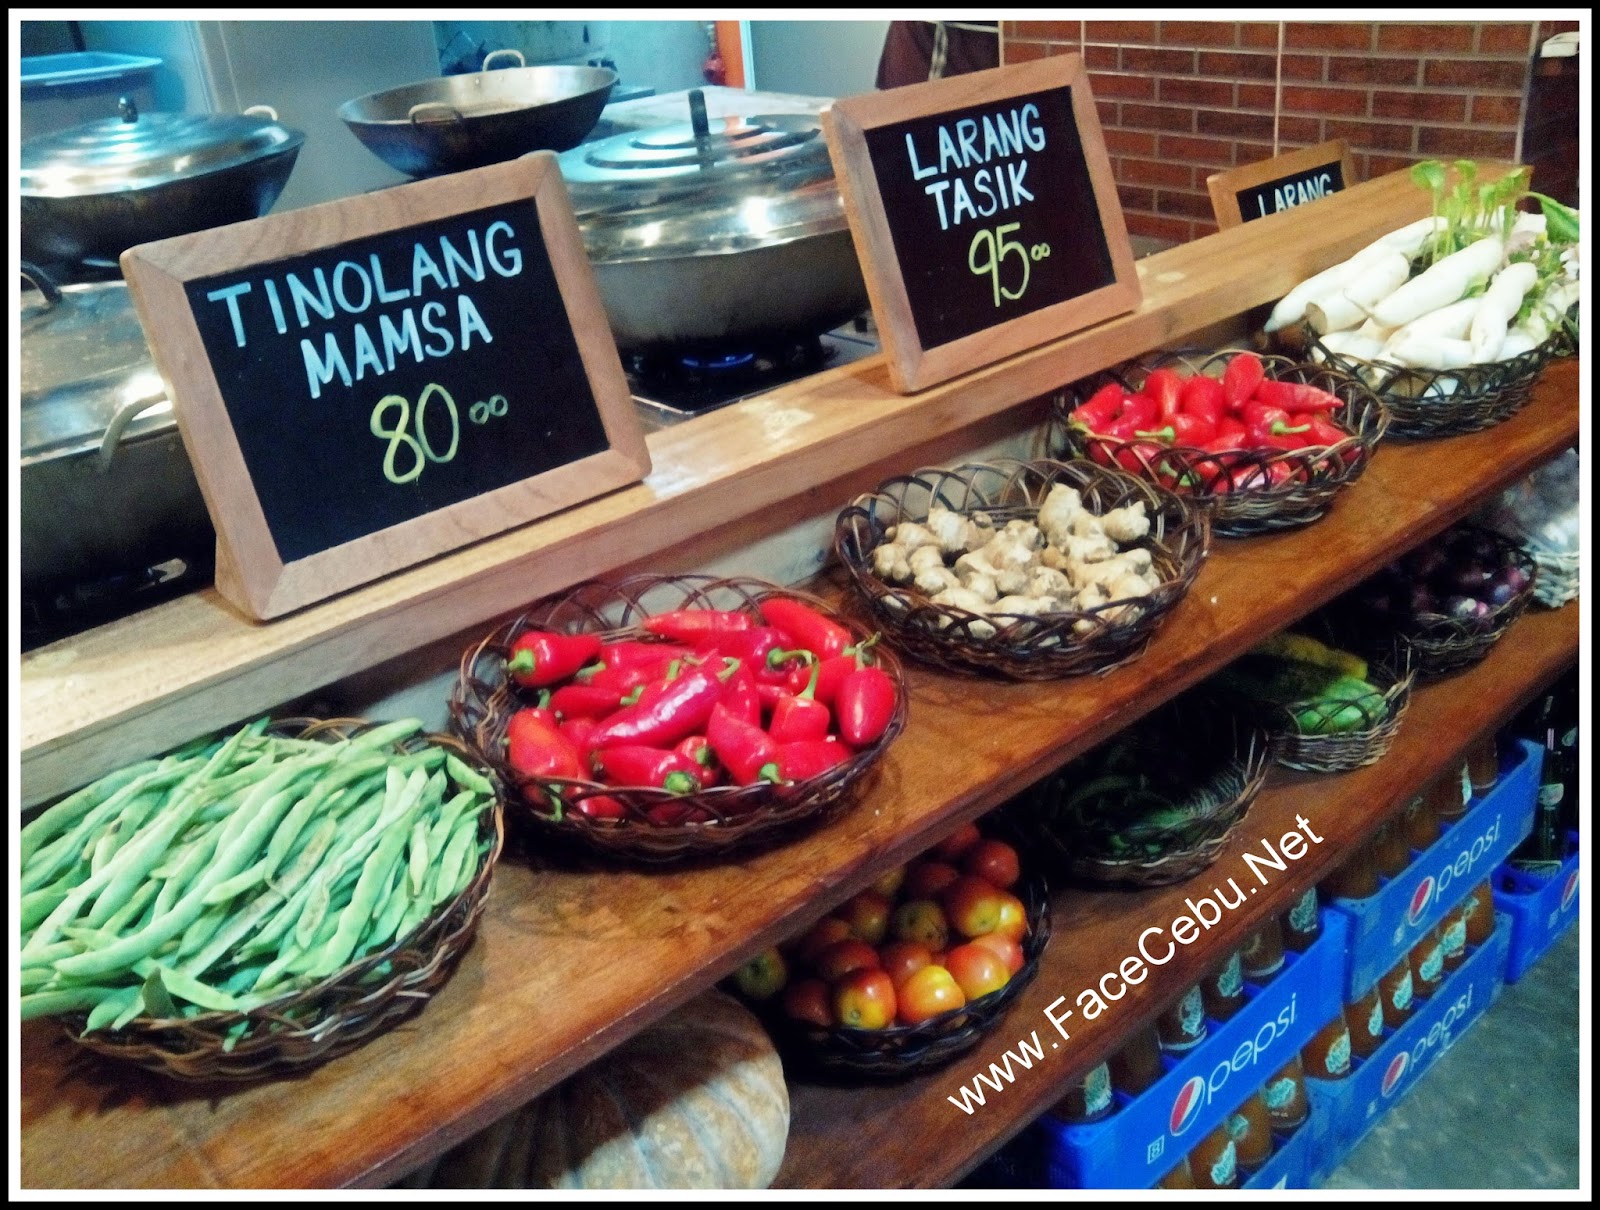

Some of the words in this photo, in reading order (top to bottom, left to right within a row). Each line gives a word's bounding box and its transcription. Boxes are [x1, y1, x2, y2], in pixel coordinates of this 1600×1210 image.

[906, 104, 1046, 181] LARANG
[925, 160, 1034, 230] TASIK
[207, 221, 523, 347] TINOLANG
[300, 295, 493, 399] MAMSA
[1435, 814, 1501, 903] pepsi
[1207, 992, 1296, 1105] pepsi
[1409, 983, 1474, 1072] pepsi
